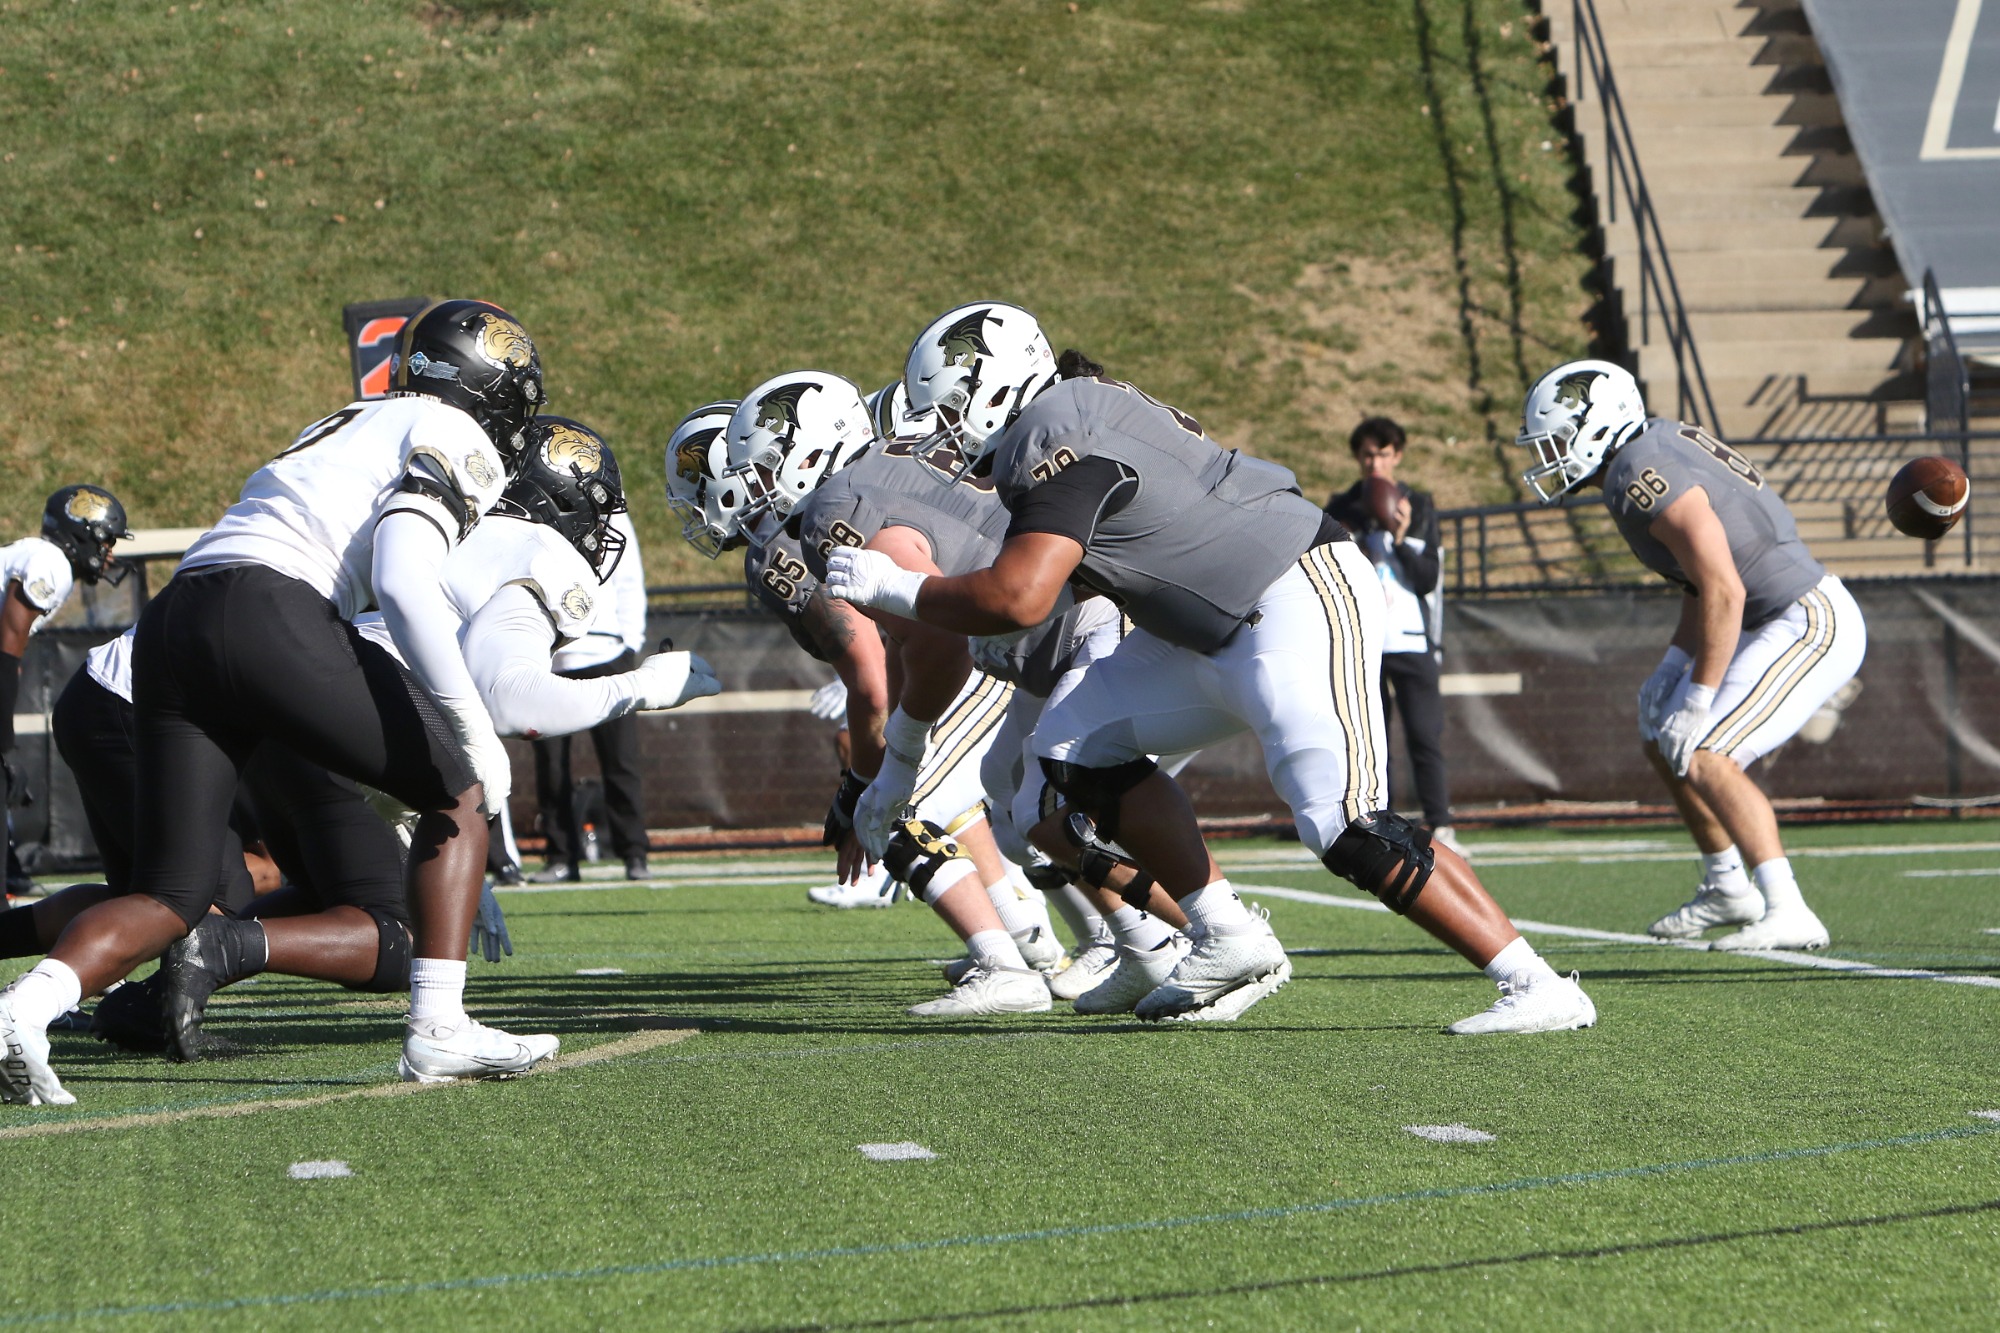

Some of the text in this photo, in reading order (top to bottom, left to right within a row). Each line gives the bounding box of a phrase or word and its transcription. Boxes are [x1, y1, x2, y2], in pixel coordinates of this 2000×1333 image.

[1025, 344, 1036, 356] 78
[834, 418, 846, 431] 68
[1626, 467, 1670, 511] 86
[762, 547, 809, 600] 65
